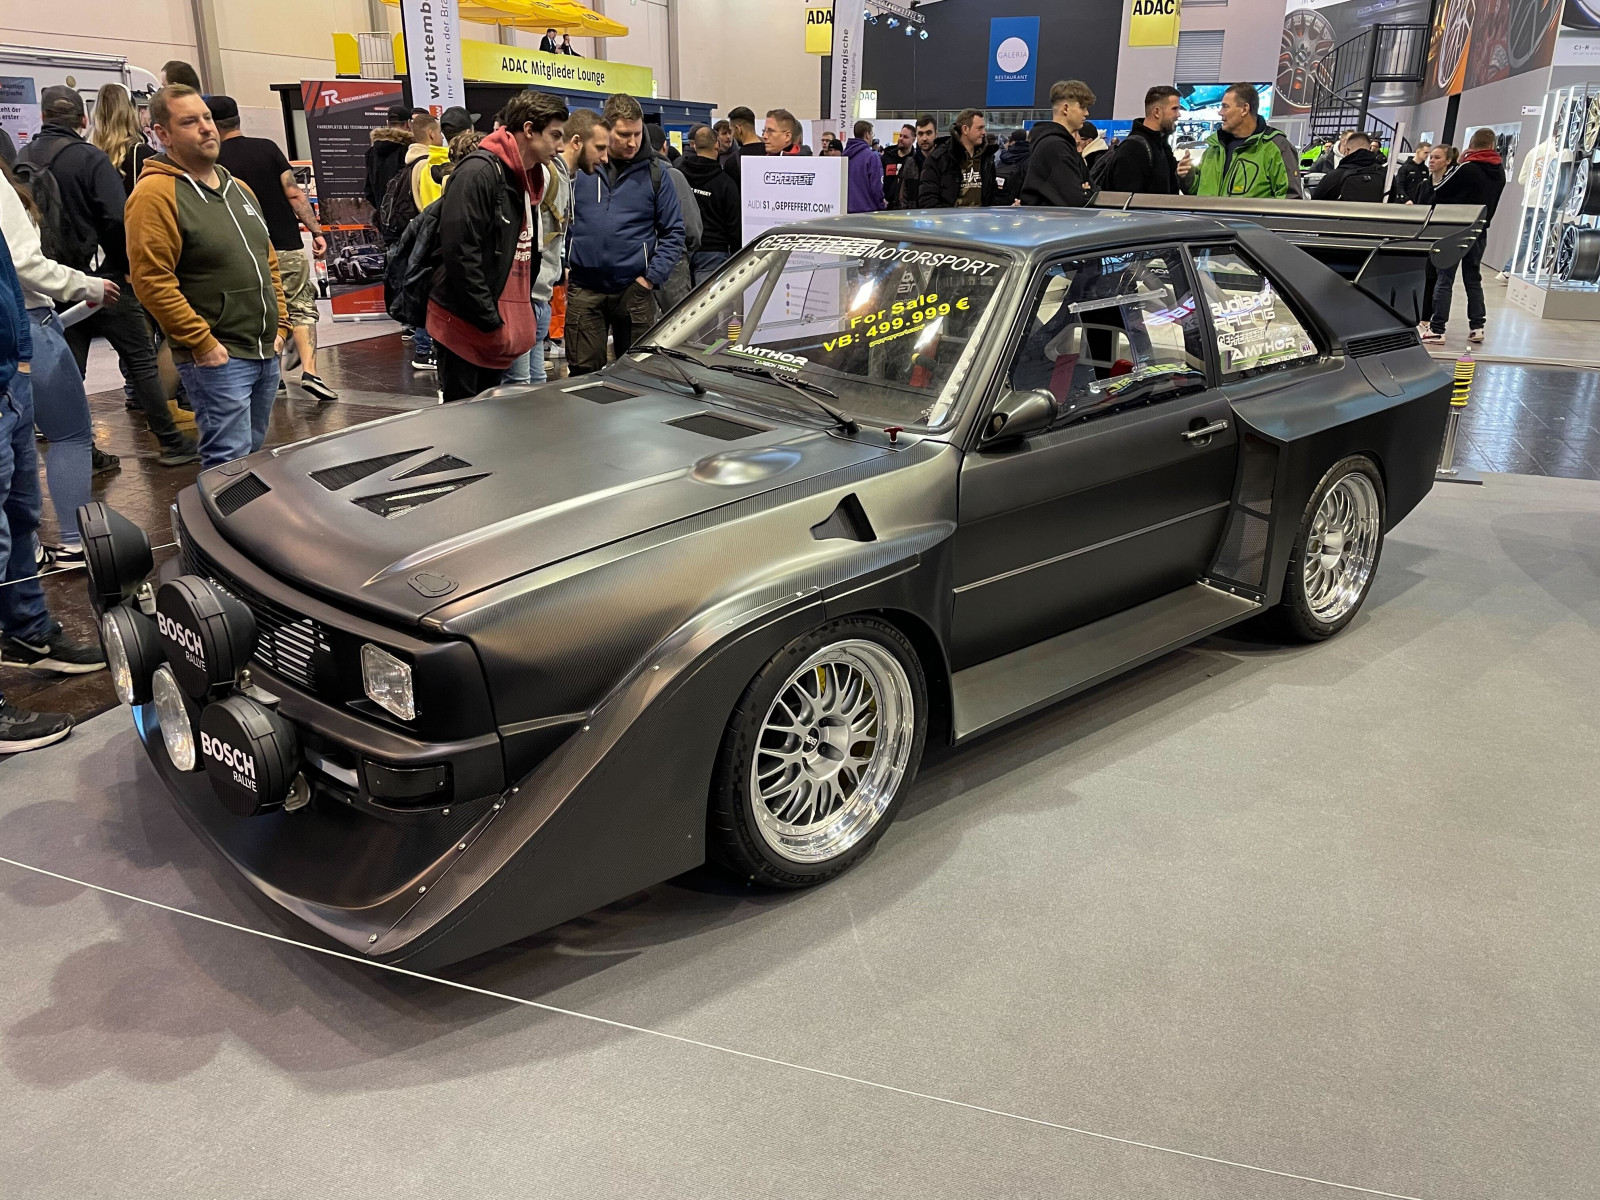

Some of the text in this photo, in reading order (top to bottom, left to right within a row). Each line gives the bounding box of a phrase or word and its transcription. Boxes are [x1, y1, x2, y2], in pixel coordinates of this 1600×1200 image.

[807, 10, 832, 25] ADA
[1132, 0, 1175, 15] ADAC
[443, 21, 451, 40] der
[420, 0, 440, 99] württemb
[501, 56, 605, 86] ADAC Mitglieder Lounge
[840, 28, 849, 129] württembergische
[860, 91, 876, 101] DAC
[747, 200, 761, 209] AUDI
[762, 200, 770, 210] S1
[863, 246, 1000, 277] MOTORSPORT
[850, 293, 938, 330] For Sale
[822, 332, 860, 353] VB:
[865, 302, 951, 338] 499.999
[956, 296, 970, 311] €
[730, 343, 808, 367] AMTHOR
[1231, 336, 1297, 361] AMTHOR
[156, 611, 205, 659] BOSCH
[185, 650, 207, 672] RALLYE
[200, 731, 256, 780] BOSCH
[232, 770, 258, 793] RALLYE
